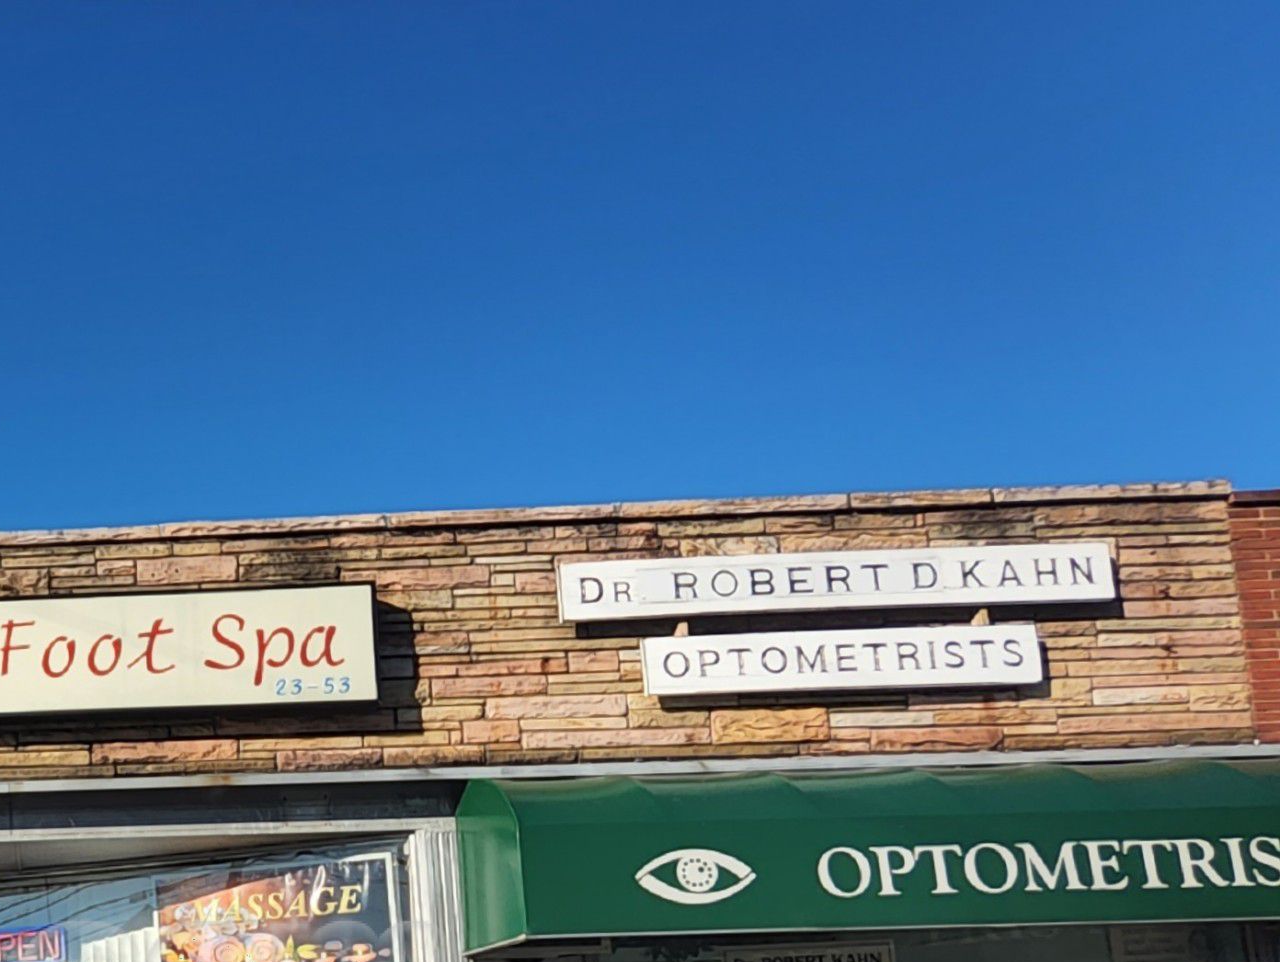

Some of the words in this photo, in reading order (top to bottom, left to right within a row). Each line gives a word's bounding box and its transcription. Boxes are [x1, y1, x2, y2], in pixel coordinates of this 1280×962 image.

[673, 564, 889, 600] ROBERT
[960, 556, 1095, 589] KAHN
[0, 617, 176, 679] Foot
[204, 613, 345, 686] Spa
[663, 639, 1025, 680] OPTOMETRISTS
[275, 677, 352, 696] 23-53
[818, 835, 1280, 899] OPTOMETRIS
[191, 883, 362, 925] MASSAGE
